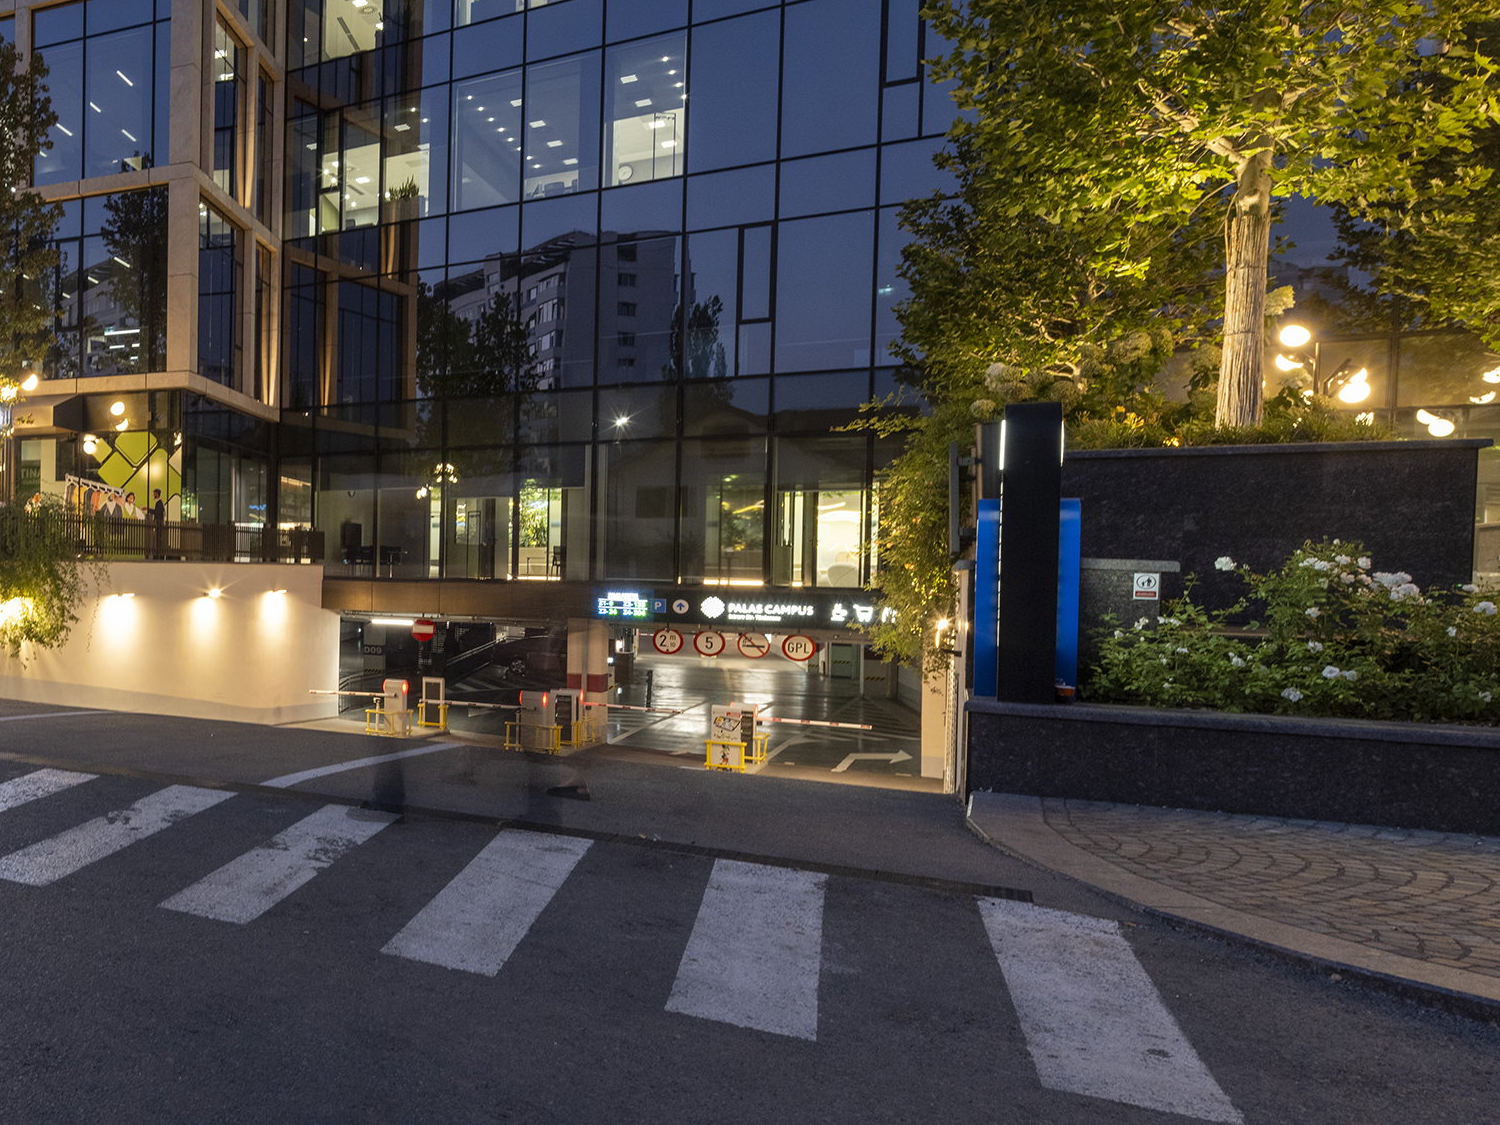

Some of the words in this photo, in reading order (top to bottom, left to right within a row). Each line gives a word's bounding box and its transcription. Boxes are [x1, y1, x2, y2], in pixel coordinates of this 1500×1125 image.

[654, 601, 662, 611] P
[728, 603, 763, 614] PALAS
[764, 604, 814, 616] CAMPUS
[705, 636, 713, 649] 5
[787, 641, 810, 654] GPL
[364, 646, 382, 654] D09
